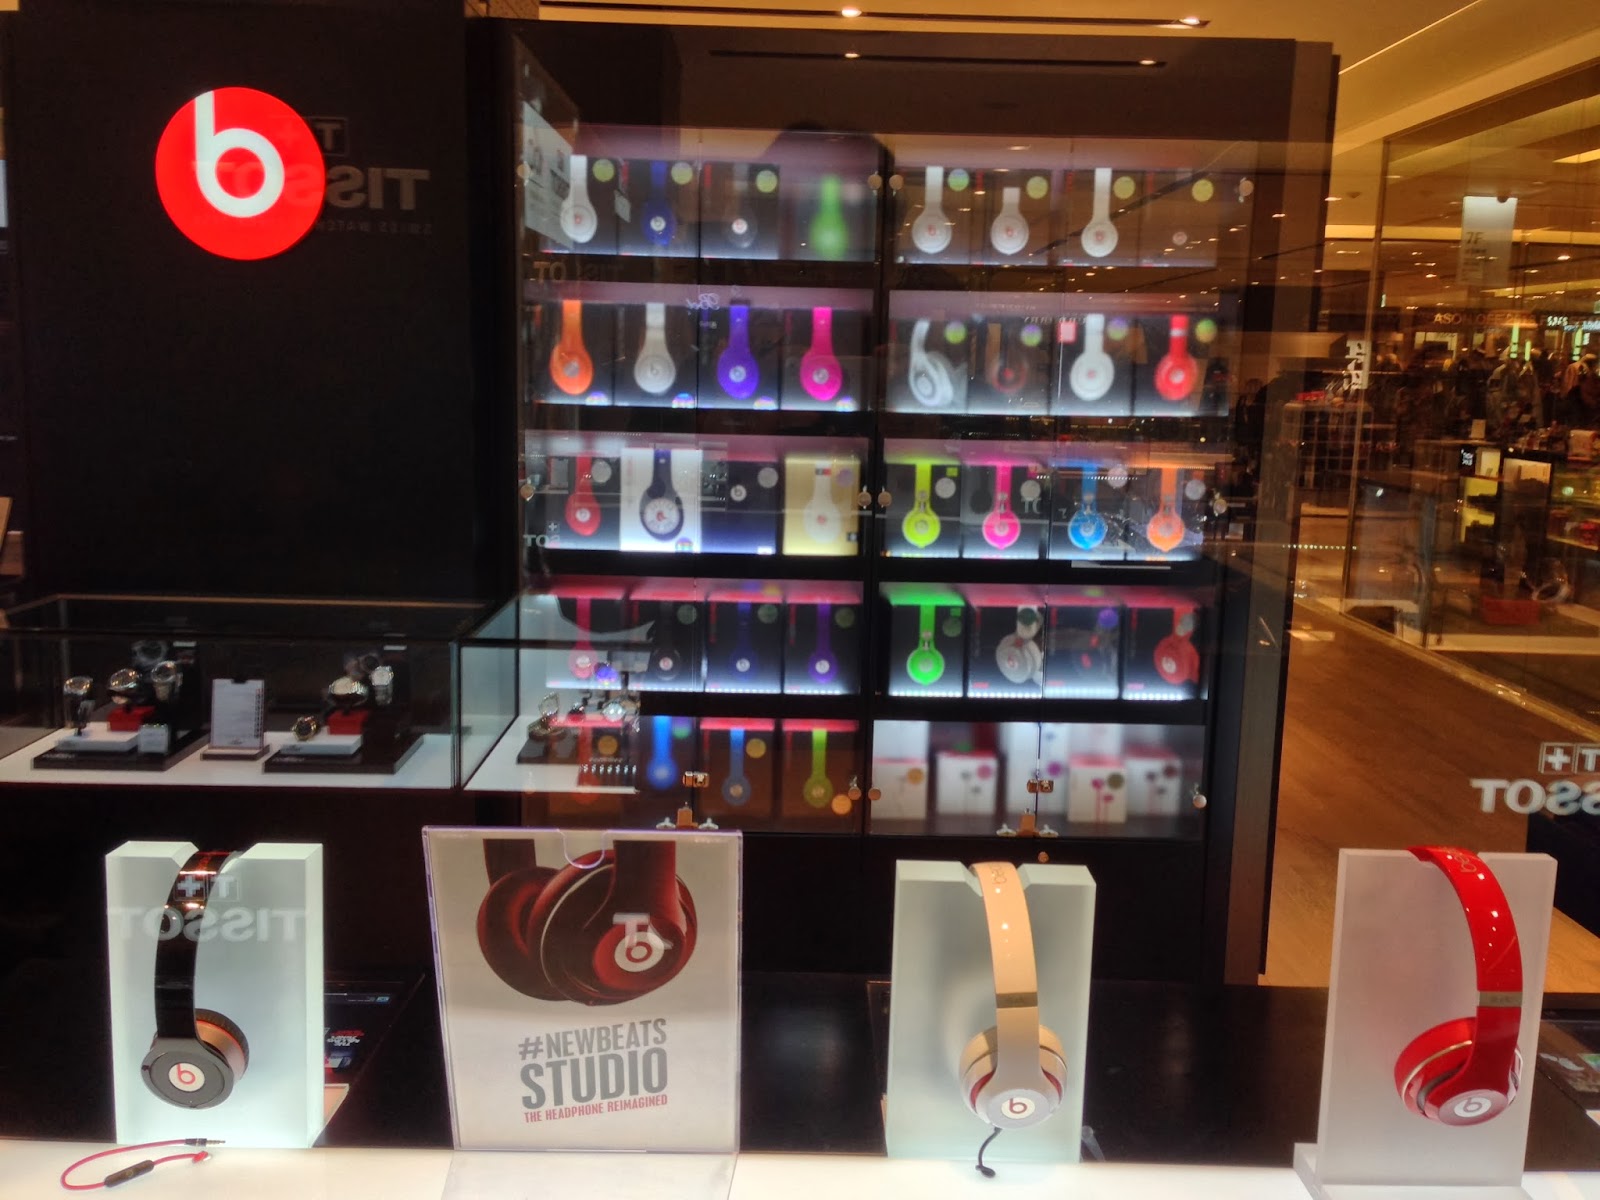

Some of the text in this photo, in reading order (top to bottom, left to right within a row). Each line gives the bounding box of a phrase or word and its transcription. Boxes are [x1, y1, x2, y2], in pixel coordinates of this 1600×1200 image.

[519, 1018, 666, 1060] #NEWBEATS
[521, 1048, 667, 1109] STUDIO
[524, 1094, 667, 1123] THE HEADPHONE REIMAGINED
